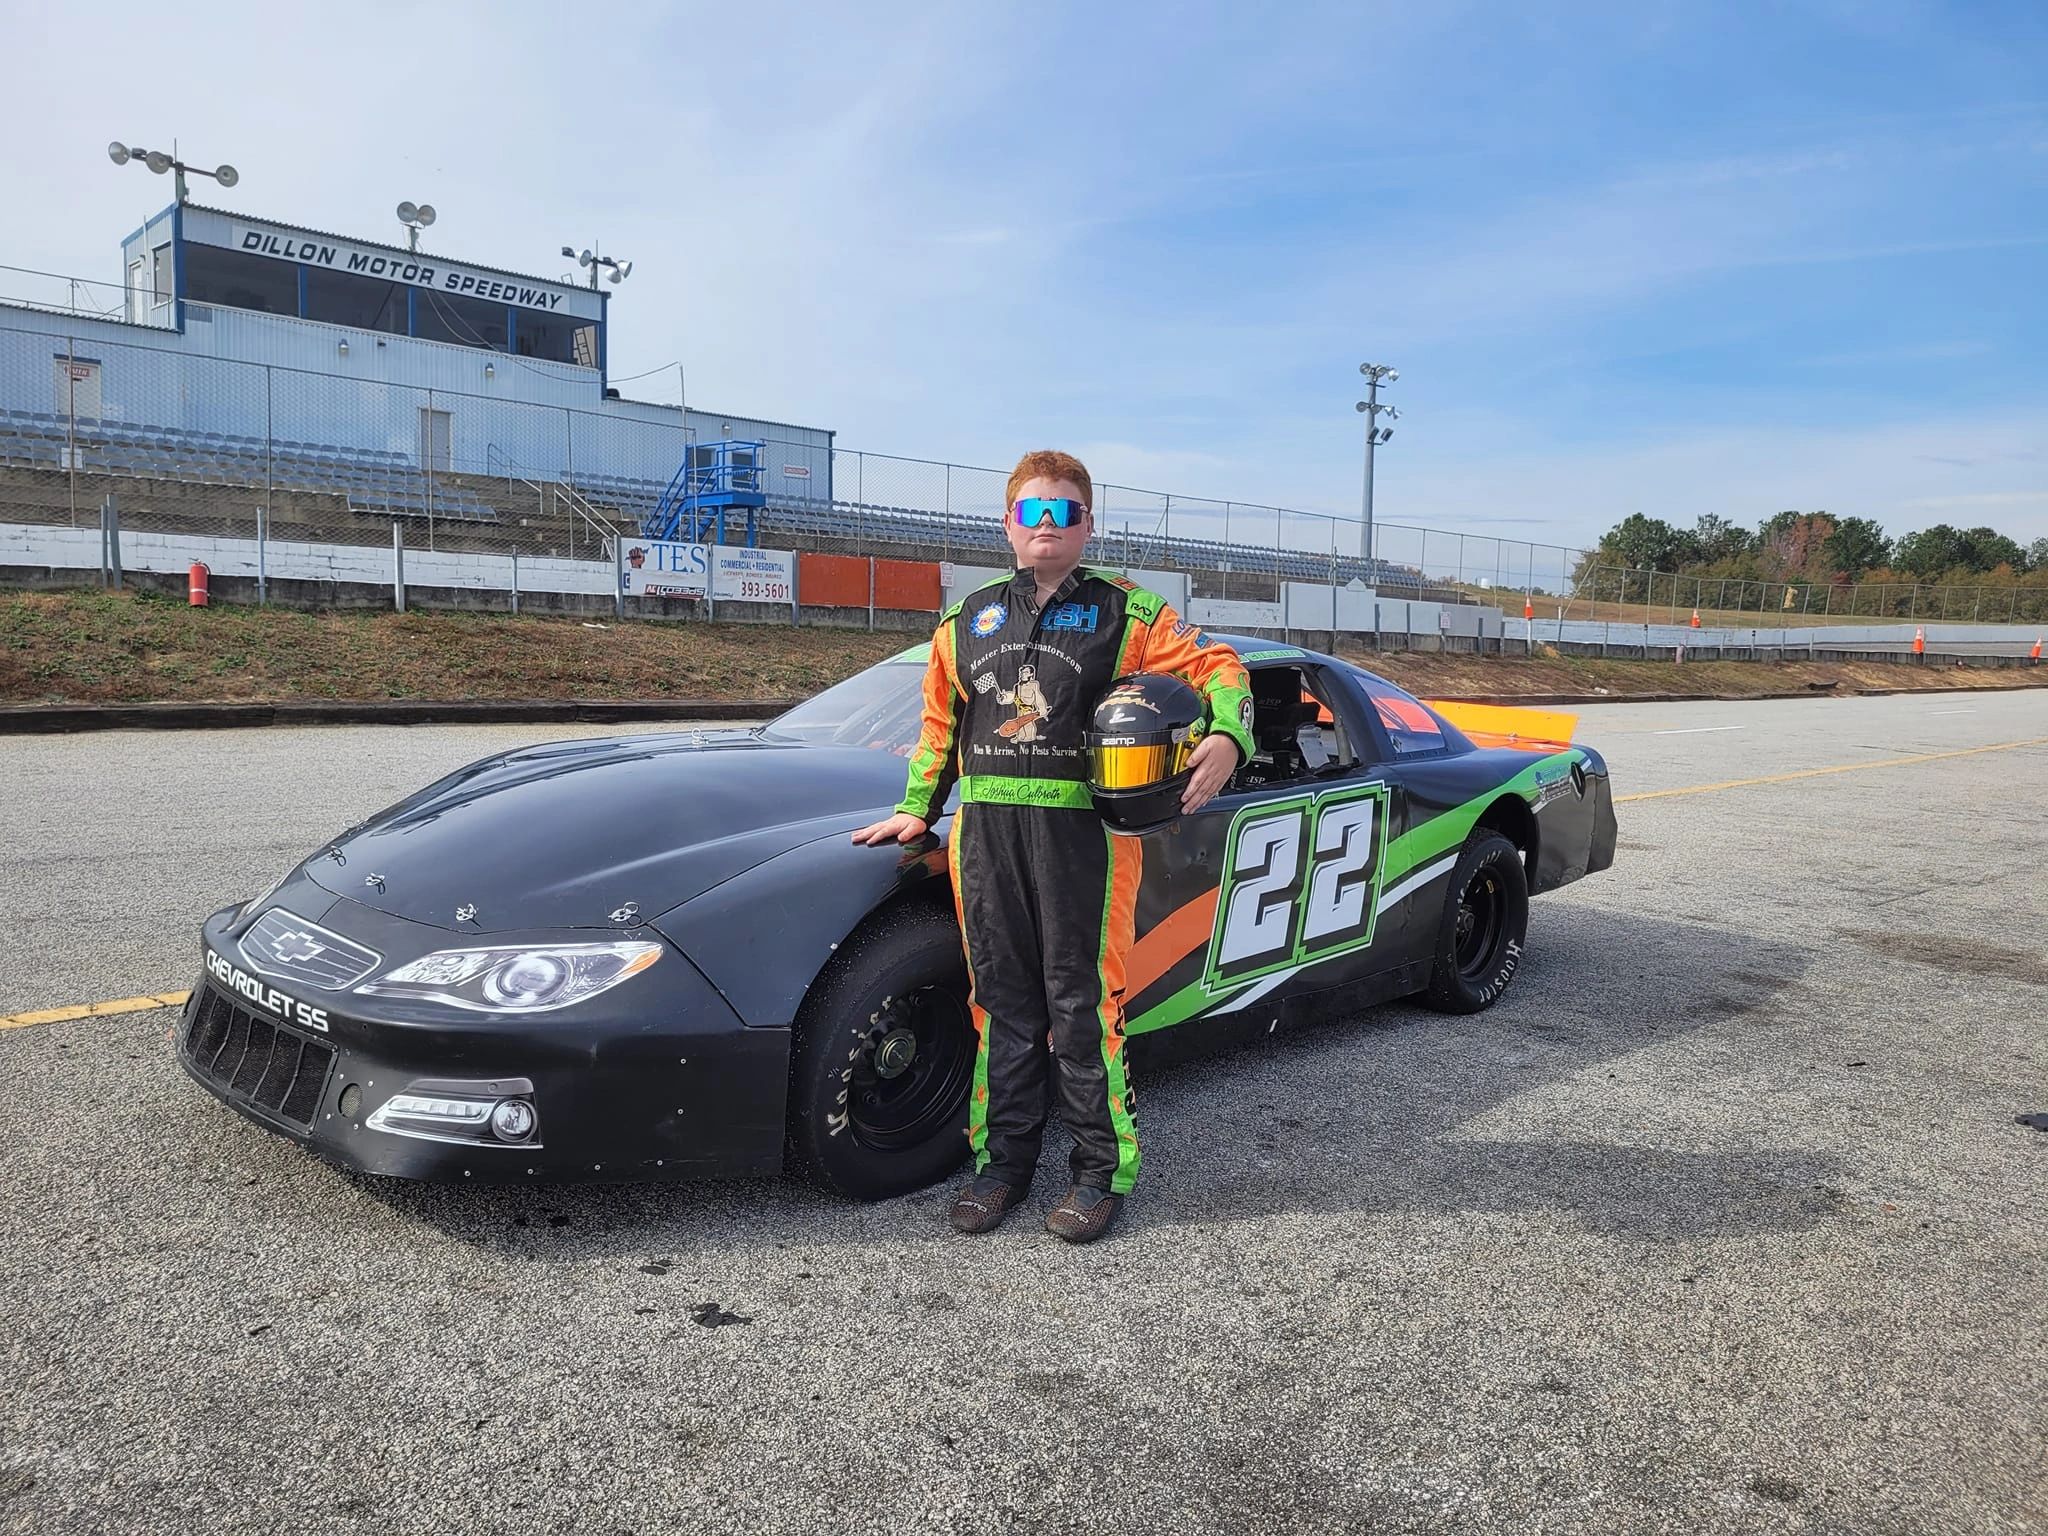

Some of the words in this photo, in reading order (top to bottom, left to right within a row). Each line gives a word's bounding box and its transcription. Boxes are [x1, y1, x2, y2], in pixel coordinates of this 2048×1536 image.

[242, 231, 336, 265] DILLON
[347, 252, 434, 285] MOTOR
[445, 273, 562, 310] SPEEDWAY
[651, 543, 706, 574] TES
[739, 550, 767, 560] INDUSTRIAL
[720, 560, 752, 570] COMMERCIAL
[755, 561, 785, 572] RESIDENTIAL
[741, 582, 789, 600] 393-5601
[1130, 602, 1153, 617] RAD
[970, 648, 998, 674] Master
[993, 744, 1017, 758] Arrive,
[1019, 743, 1030, 756] No
[1032, 743, 1050, 756] Pests
[1052, 745, 1078, 757] Survive
[1101, 737, 1136, 747] zamp
[981, 781, 1016, 798] Joshua
[1016, 784, 1061, 801] Culbreth
[1219, 798, 1374, 966] 22
[206, 949, 294, 1018] CHEVROLET
[296, 1002, 329, 1032] SS
